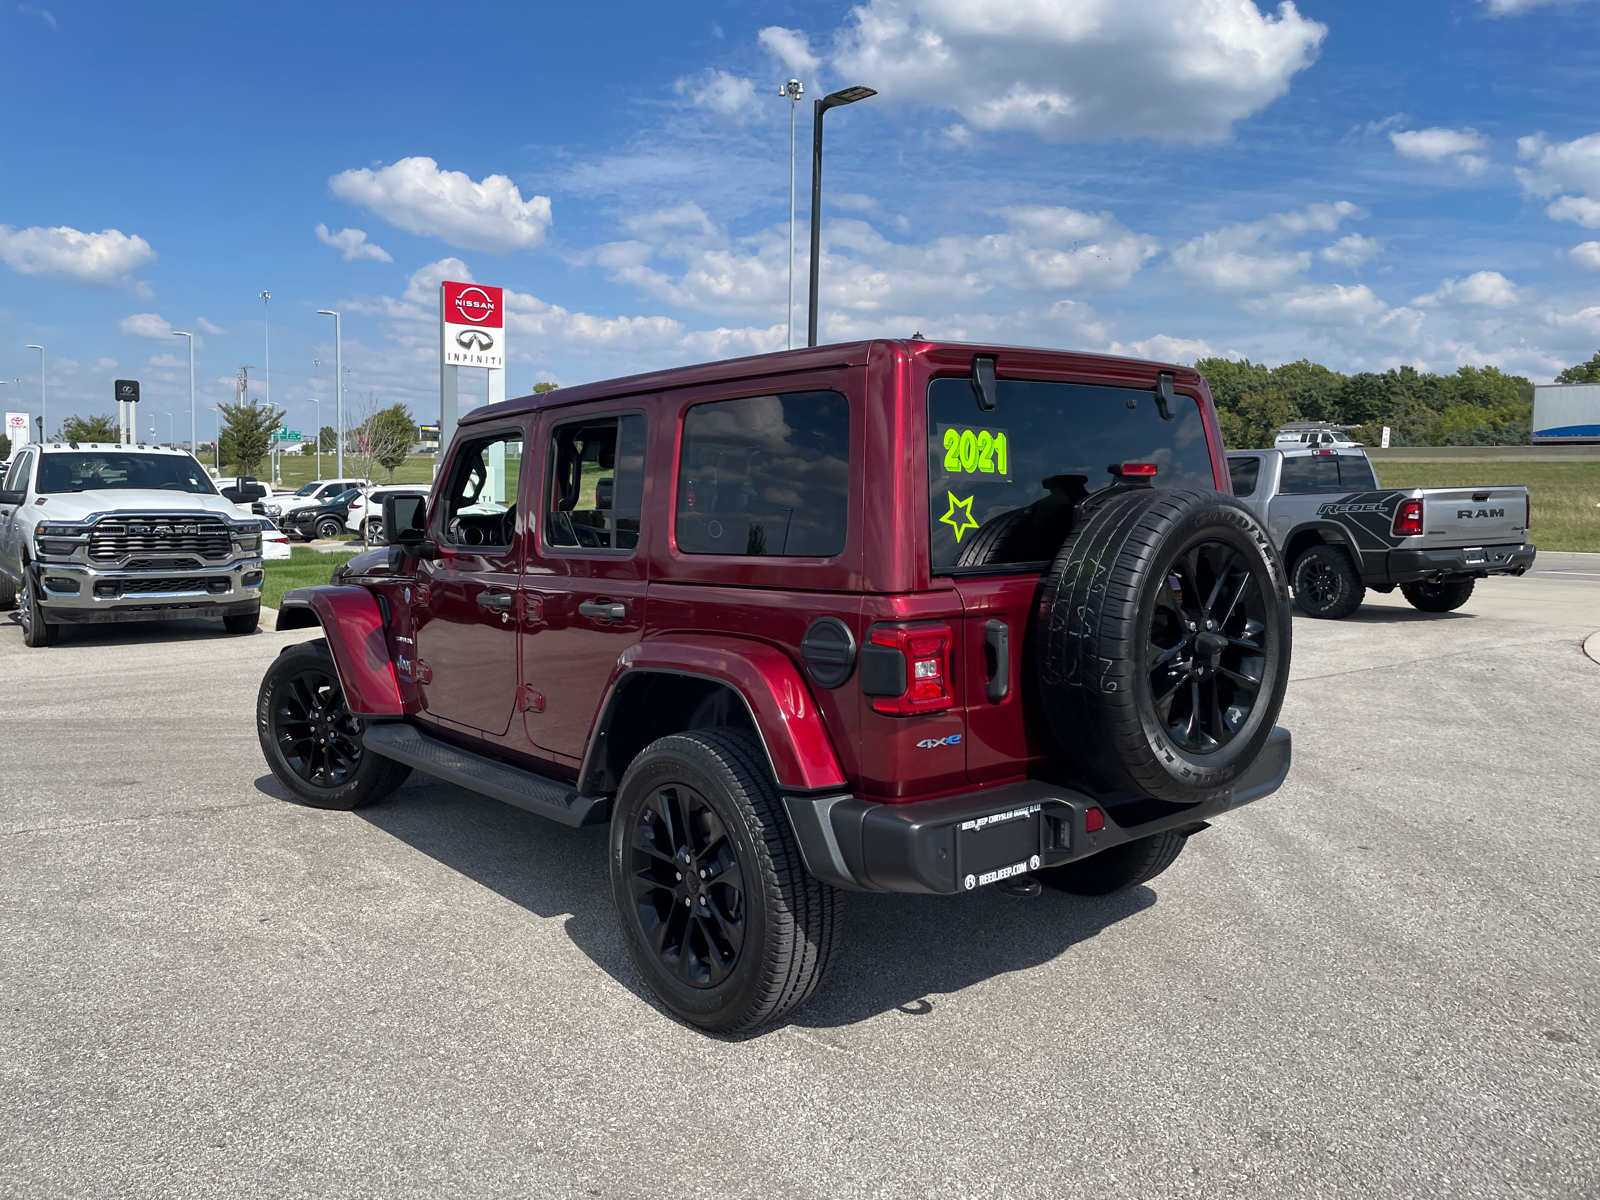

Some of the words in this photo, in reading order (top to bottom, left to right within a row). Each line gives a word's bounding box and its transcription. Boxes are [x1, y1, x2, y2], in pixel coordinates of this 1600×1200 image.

[455, 299, 494, 309] NISSAN
[447, 352, 502, 365] INFINITI
[943, 428, 1007, 475] 2021
[1316, 502, 1389, 516] REBEL
[1457, 508, 1504, 519] RAM
[128, 525, 197, 534] RAM
[975, 817, 988, 828] JEEP
[988, 811, 1013, 824] CHRYSLER
[979, 862, 1027, 886] REEDJEEP.COM
